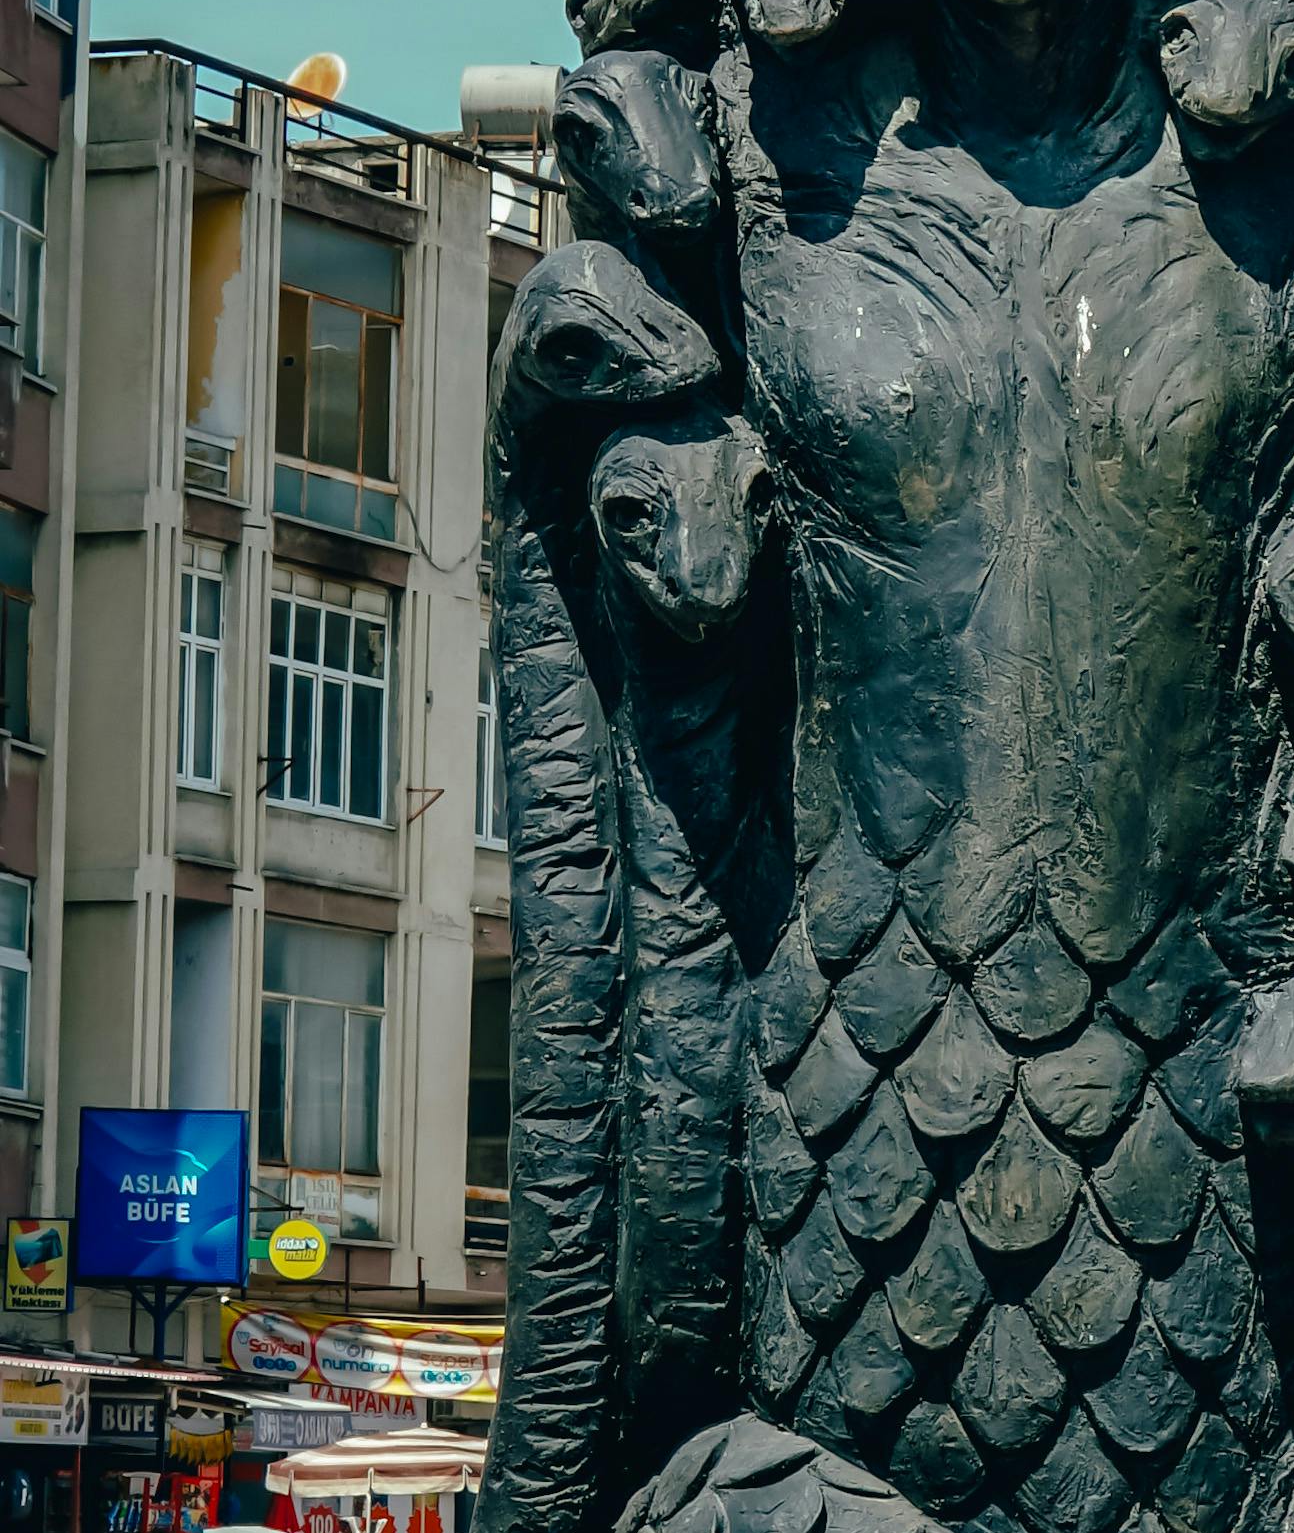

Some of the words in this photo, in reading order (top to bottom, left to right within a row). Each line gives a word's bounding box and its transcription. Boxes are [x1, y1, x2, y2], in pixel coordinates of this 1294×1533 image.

[119, 1174, 198, 1196] ASLAN
[127, 1198, 191, 1223] BÜFE
[321, 1357, 391, 1374] numara
[102, 1403, 155, 1432] BÜFE
